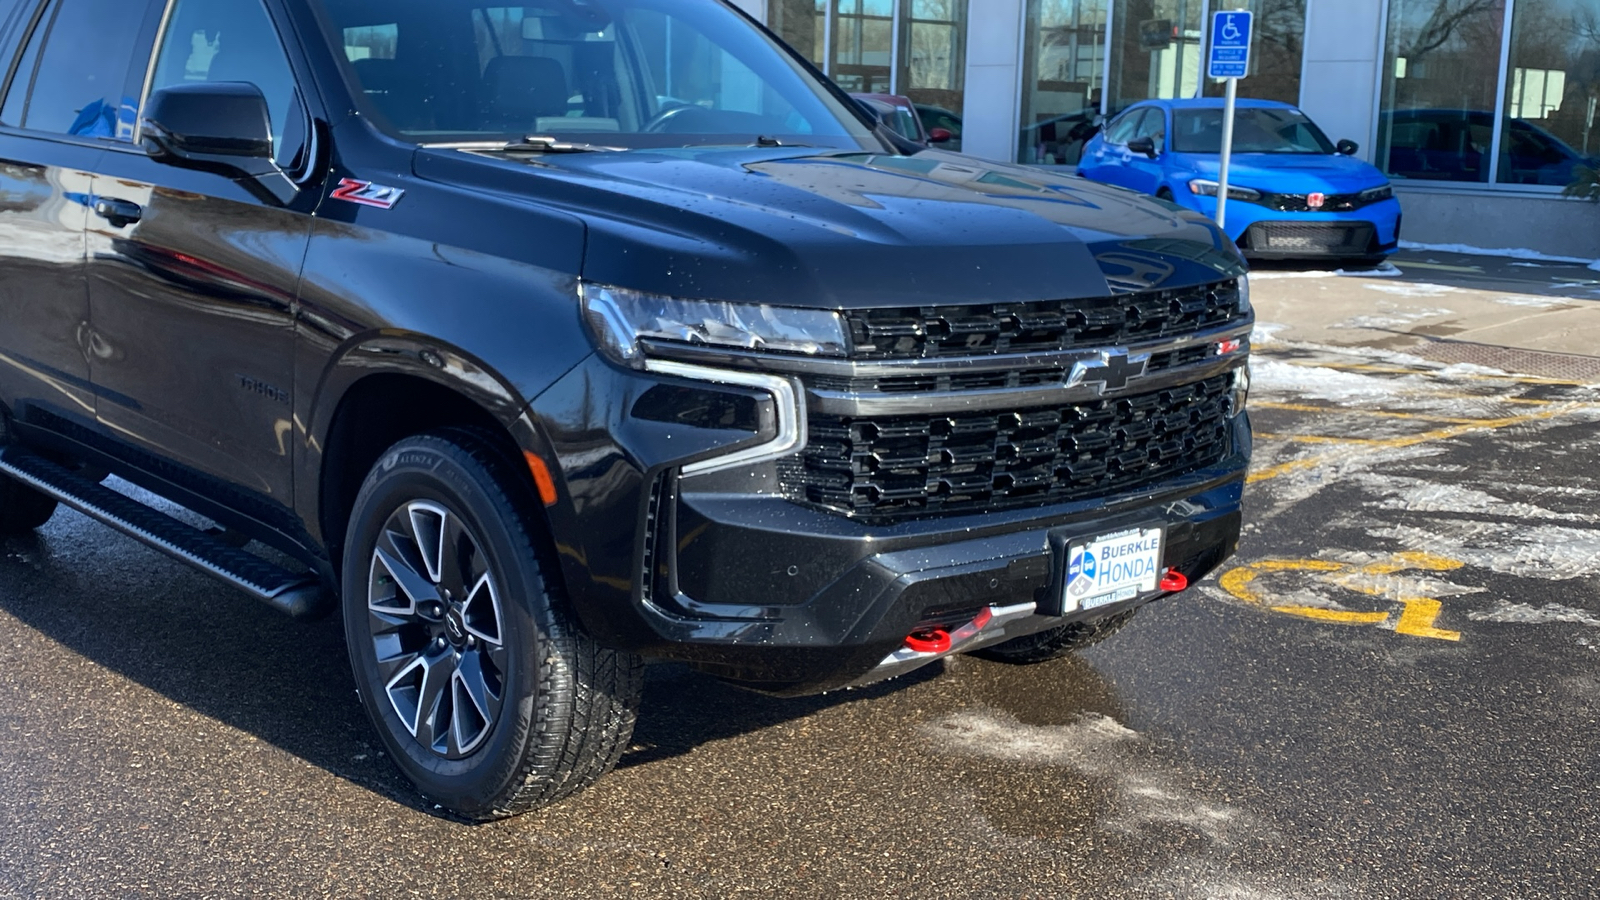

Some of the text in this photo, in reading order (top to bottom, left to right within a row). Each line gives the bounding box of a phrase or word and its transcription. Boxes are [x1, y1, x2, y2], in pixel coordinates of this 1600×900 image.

[329, 177, 405, 209] Z71
[234, 373, 290, 405] TAHOE
[1101, 538, 1159, 560] BUERKLE
[1098, 556, 1155, 586] HONDA
[1084, 588, 1135, 608] BUERKLE HONDA
